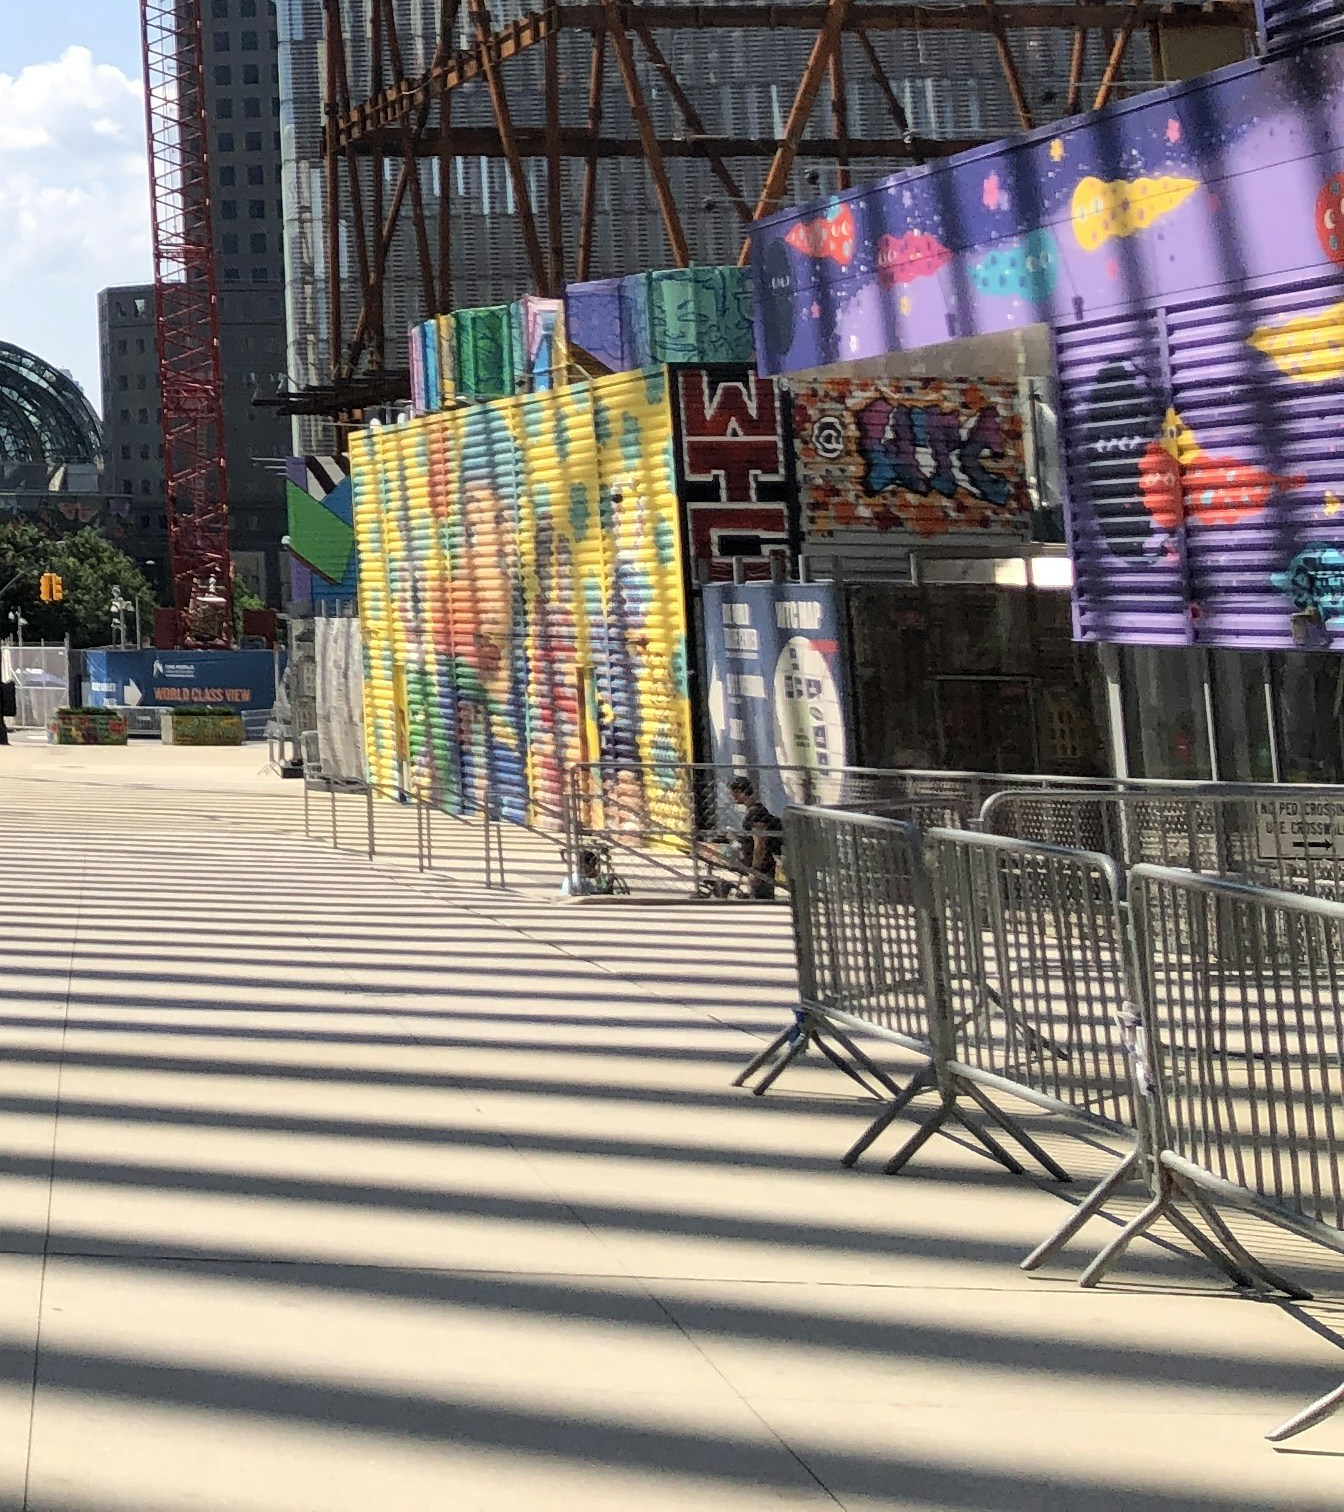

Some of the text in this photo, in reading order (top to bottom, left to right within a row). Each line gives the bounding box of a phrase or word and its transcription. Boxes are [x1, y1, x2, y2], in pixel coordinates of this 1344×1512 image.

[154, 687, 252, 702] WORLD CLASS VIEW
[1280, 801, 1298, 815] PED
[1266, 821, 1287, 834] UE
